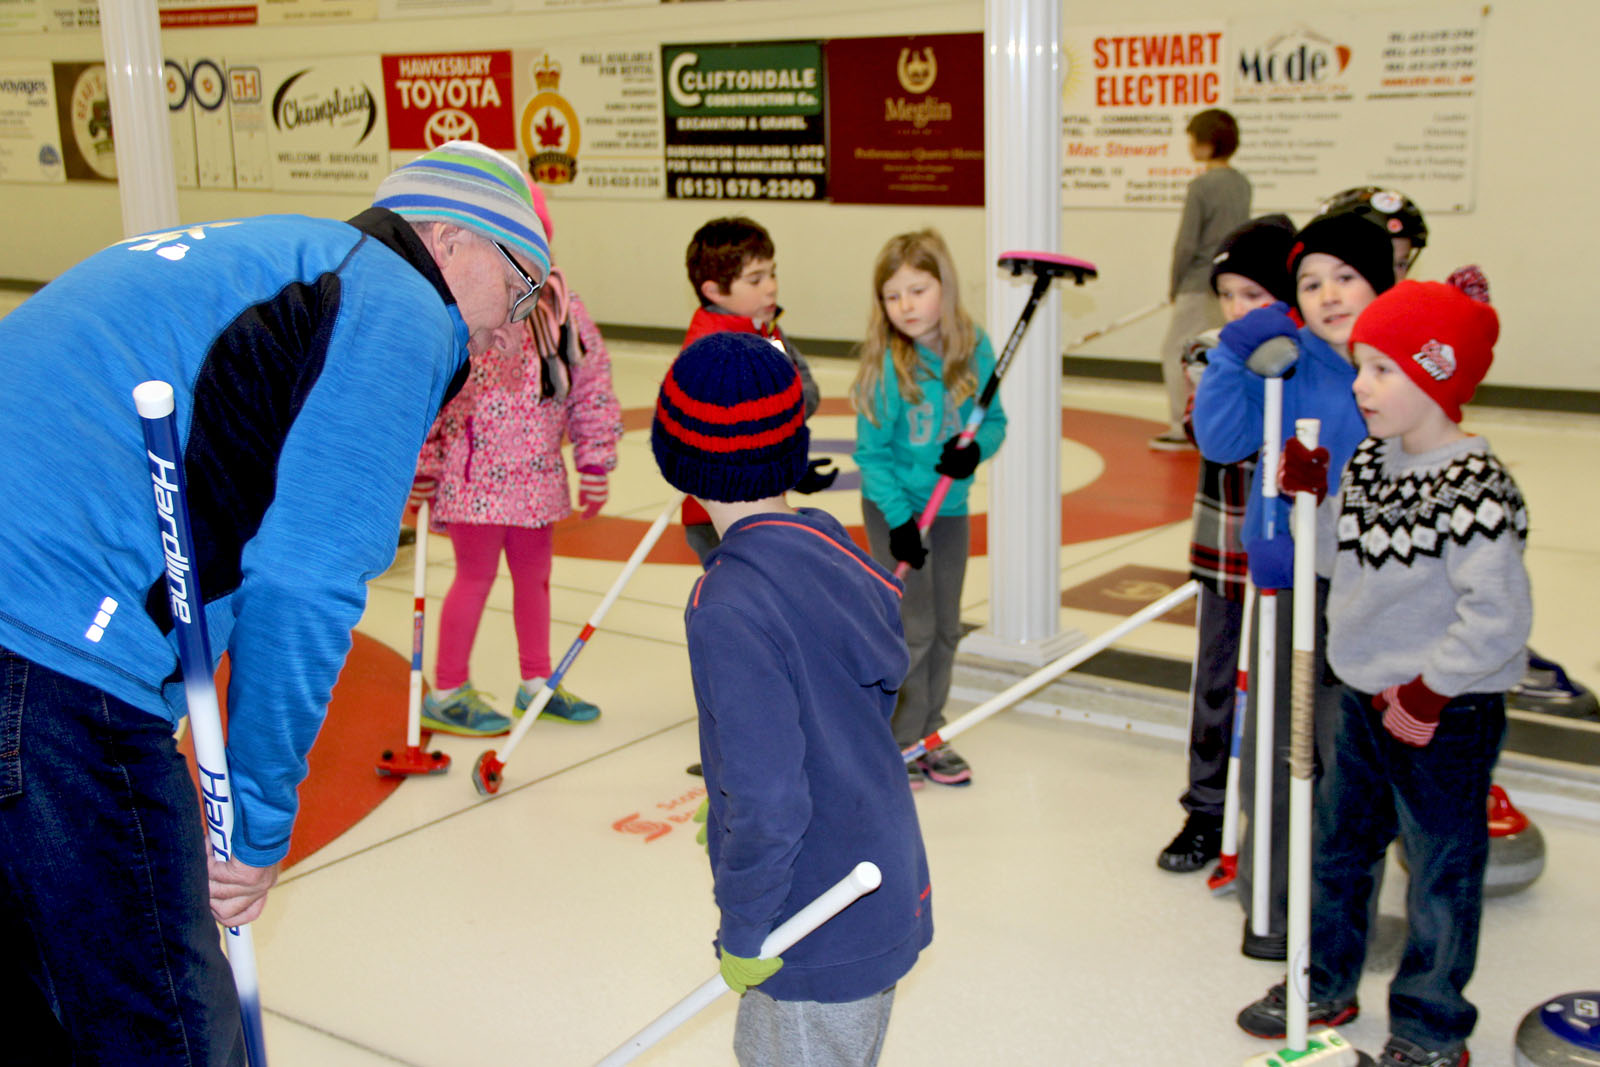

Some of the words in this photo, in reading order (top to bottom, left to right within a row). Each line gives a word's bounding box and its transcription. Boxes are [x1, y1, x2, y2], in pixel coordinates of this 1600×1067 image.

[1093, 32, 1223, 70] STEWART
[398, 55, 492, 78] HAWKESBURY
[1238, 46, 1328, 85] Mode
[682, 68, 817, 91] CLIFTONDALE
[1095, 72, 1220, 108] ELECTRIC
[395, 78, 502, 110] TOYOTA
[705, 92, 796, 107] CONSTRUCTION
[283, 85, 371, 130] Champlain
[676, 117, 747, 131] EXCAVATION
[666, 145, 734, 159] SUBDIVISION
[735, 145, 791, 159] BUILDING
[792, 144, 826, 159] LOTS
[1066, 142, 1101, 157] Mac
[1104, 141, 1169, 158] Stewart
[667, 160, 689, 173] FOR
[689, 160, 719, 174] SALE
[720, 160, 734, 173] IN
[675, 177, 724, 199] (613)
[725, 178, 817, 199] 678-2300
[147, 449, 192, 625] Hardline
